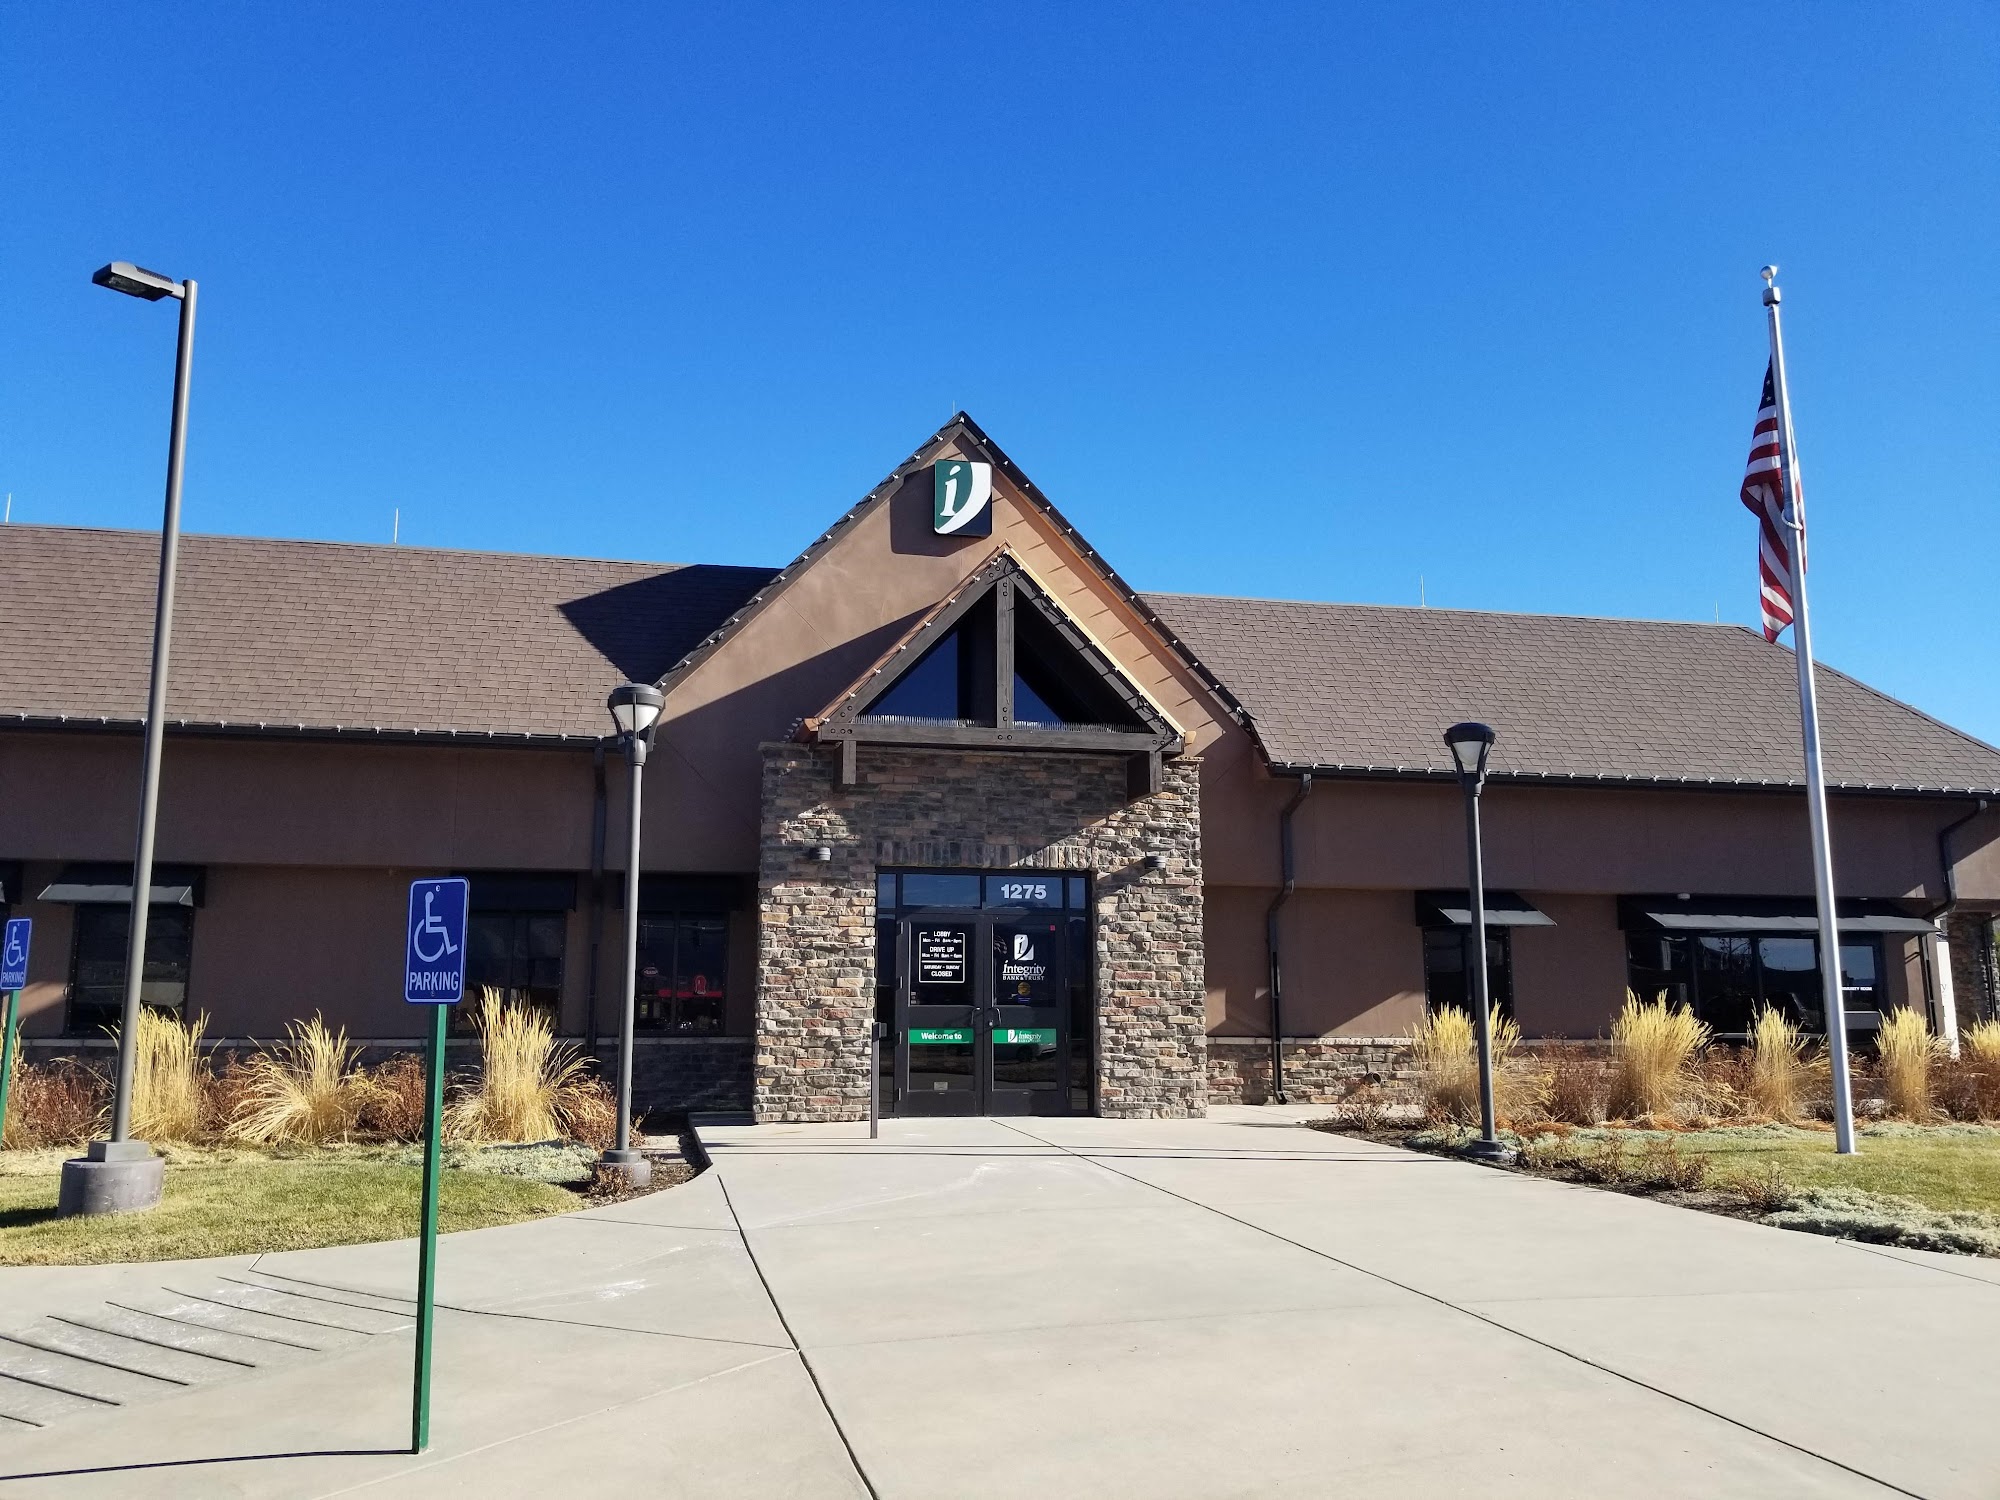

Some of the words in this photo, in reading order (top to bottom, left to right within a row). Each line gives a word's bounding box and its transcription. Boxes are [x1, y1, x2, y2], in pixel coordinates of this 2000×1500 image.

[1001, 884, 1047, 900] 1275
[3, 971, 24, 983] PARKING
[409, 971, 459, 991] PARKING
[920, 1032, 954, 1040] Welcome
[953, 1032, 963, 1040] to
